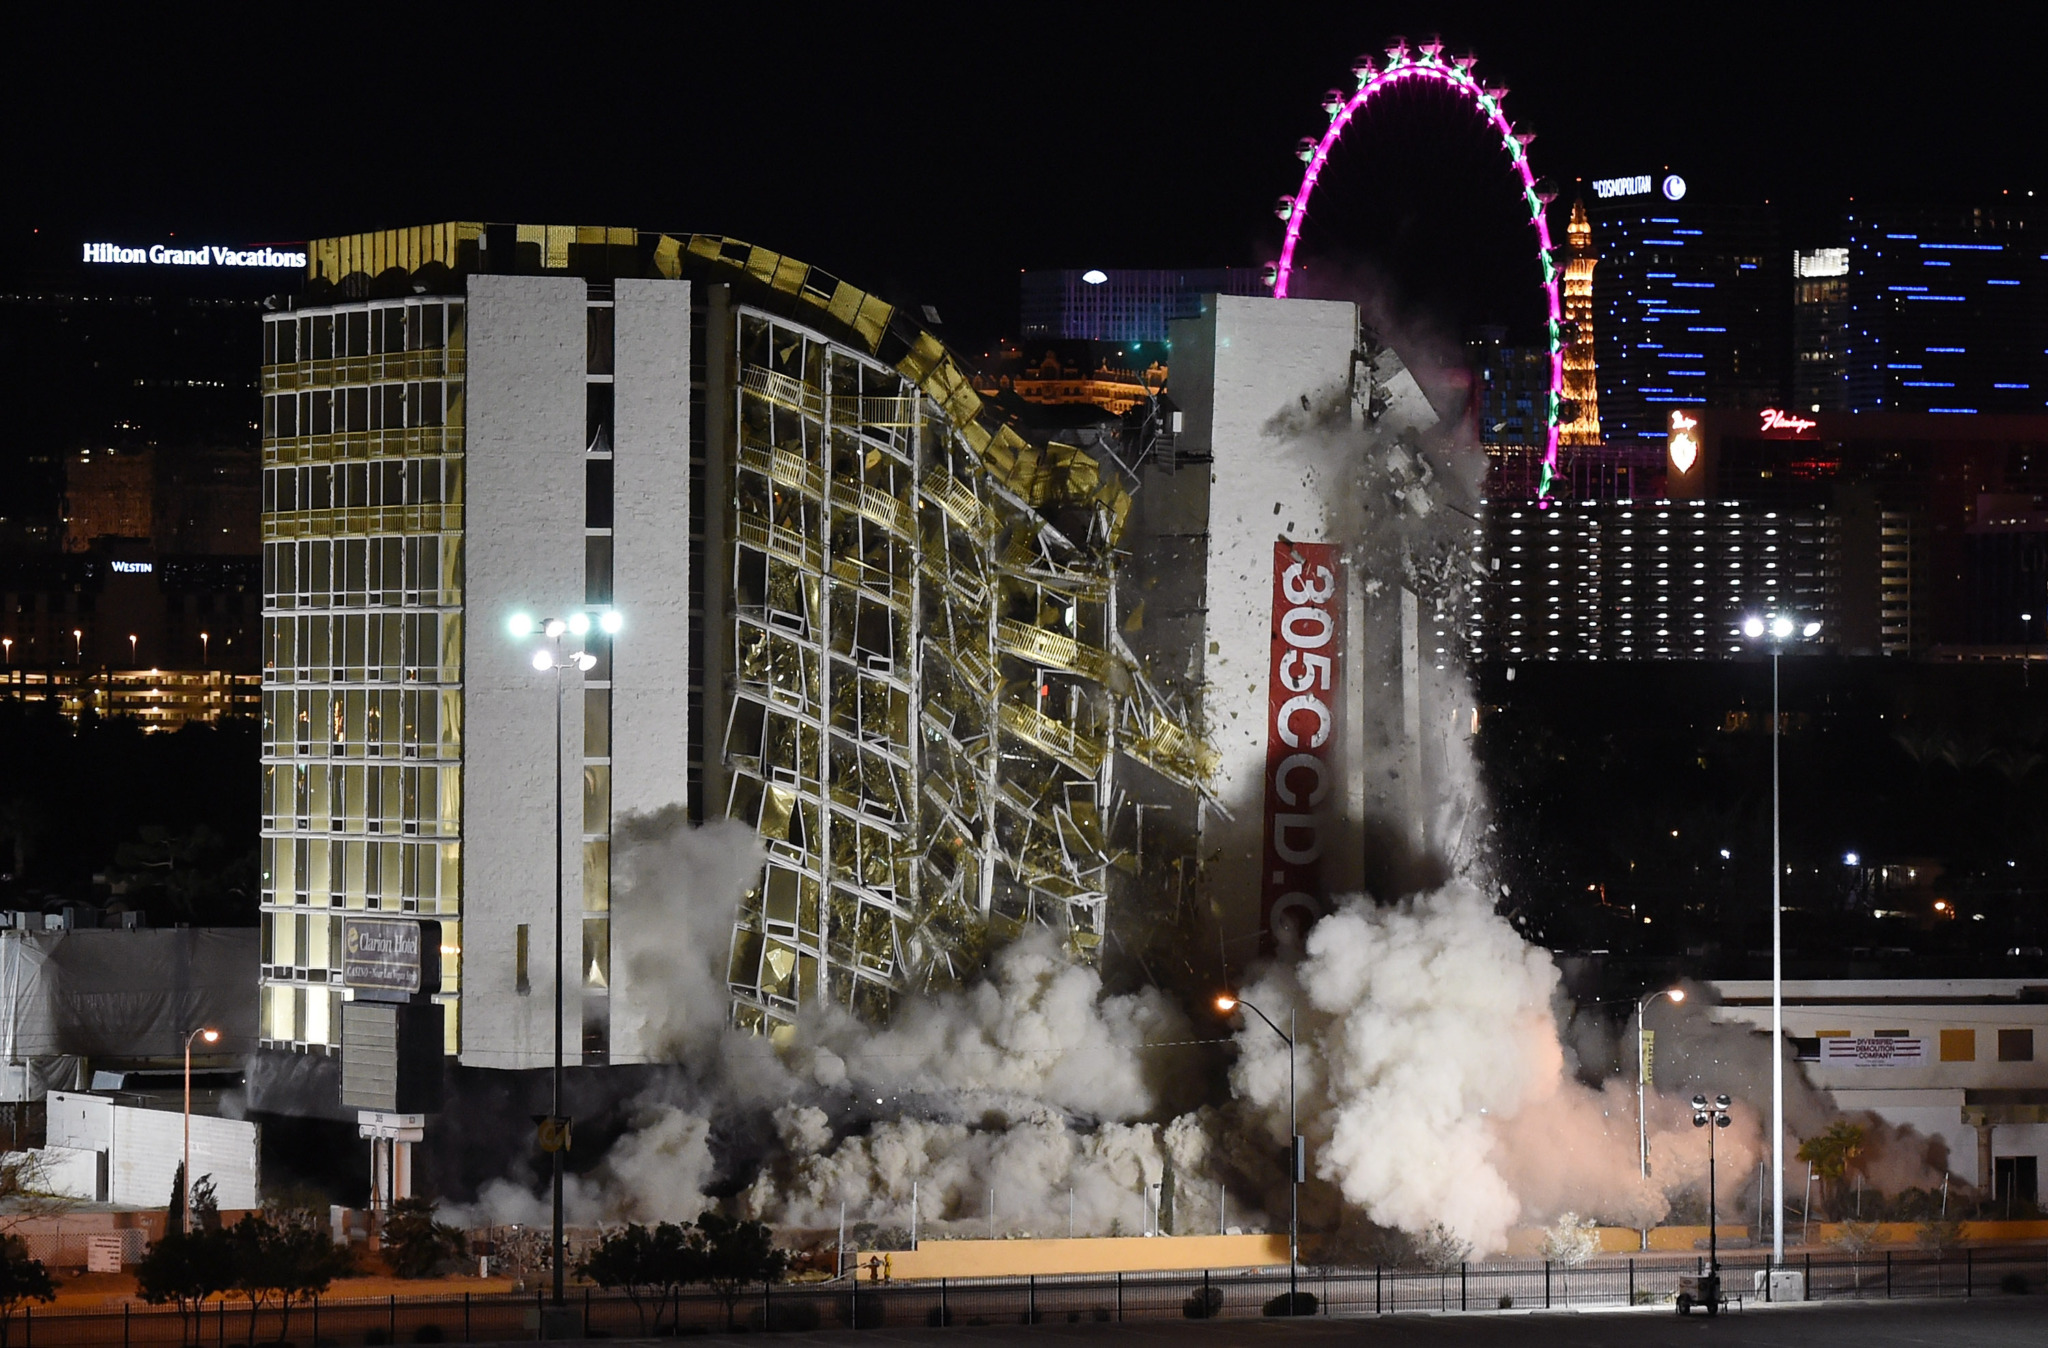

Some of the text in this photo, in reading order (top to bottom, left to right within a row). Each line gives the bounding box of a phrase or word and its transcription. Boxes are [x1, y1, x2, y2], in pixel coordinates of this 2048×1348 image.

[1598, 175, 1652, 198] COSMOPOLITAN
[83, 242, 307, 267] Hilton Grand Vacations
[1760, 408, 1816, 433] Flamingo
[359, 932, 418, 955] Clarion Hotel
[347, 966, 369, 978] CASINO
[383, 967, 392, 979] Las
[1857, 1038, 1893, 1046] DIVERSIFIED
